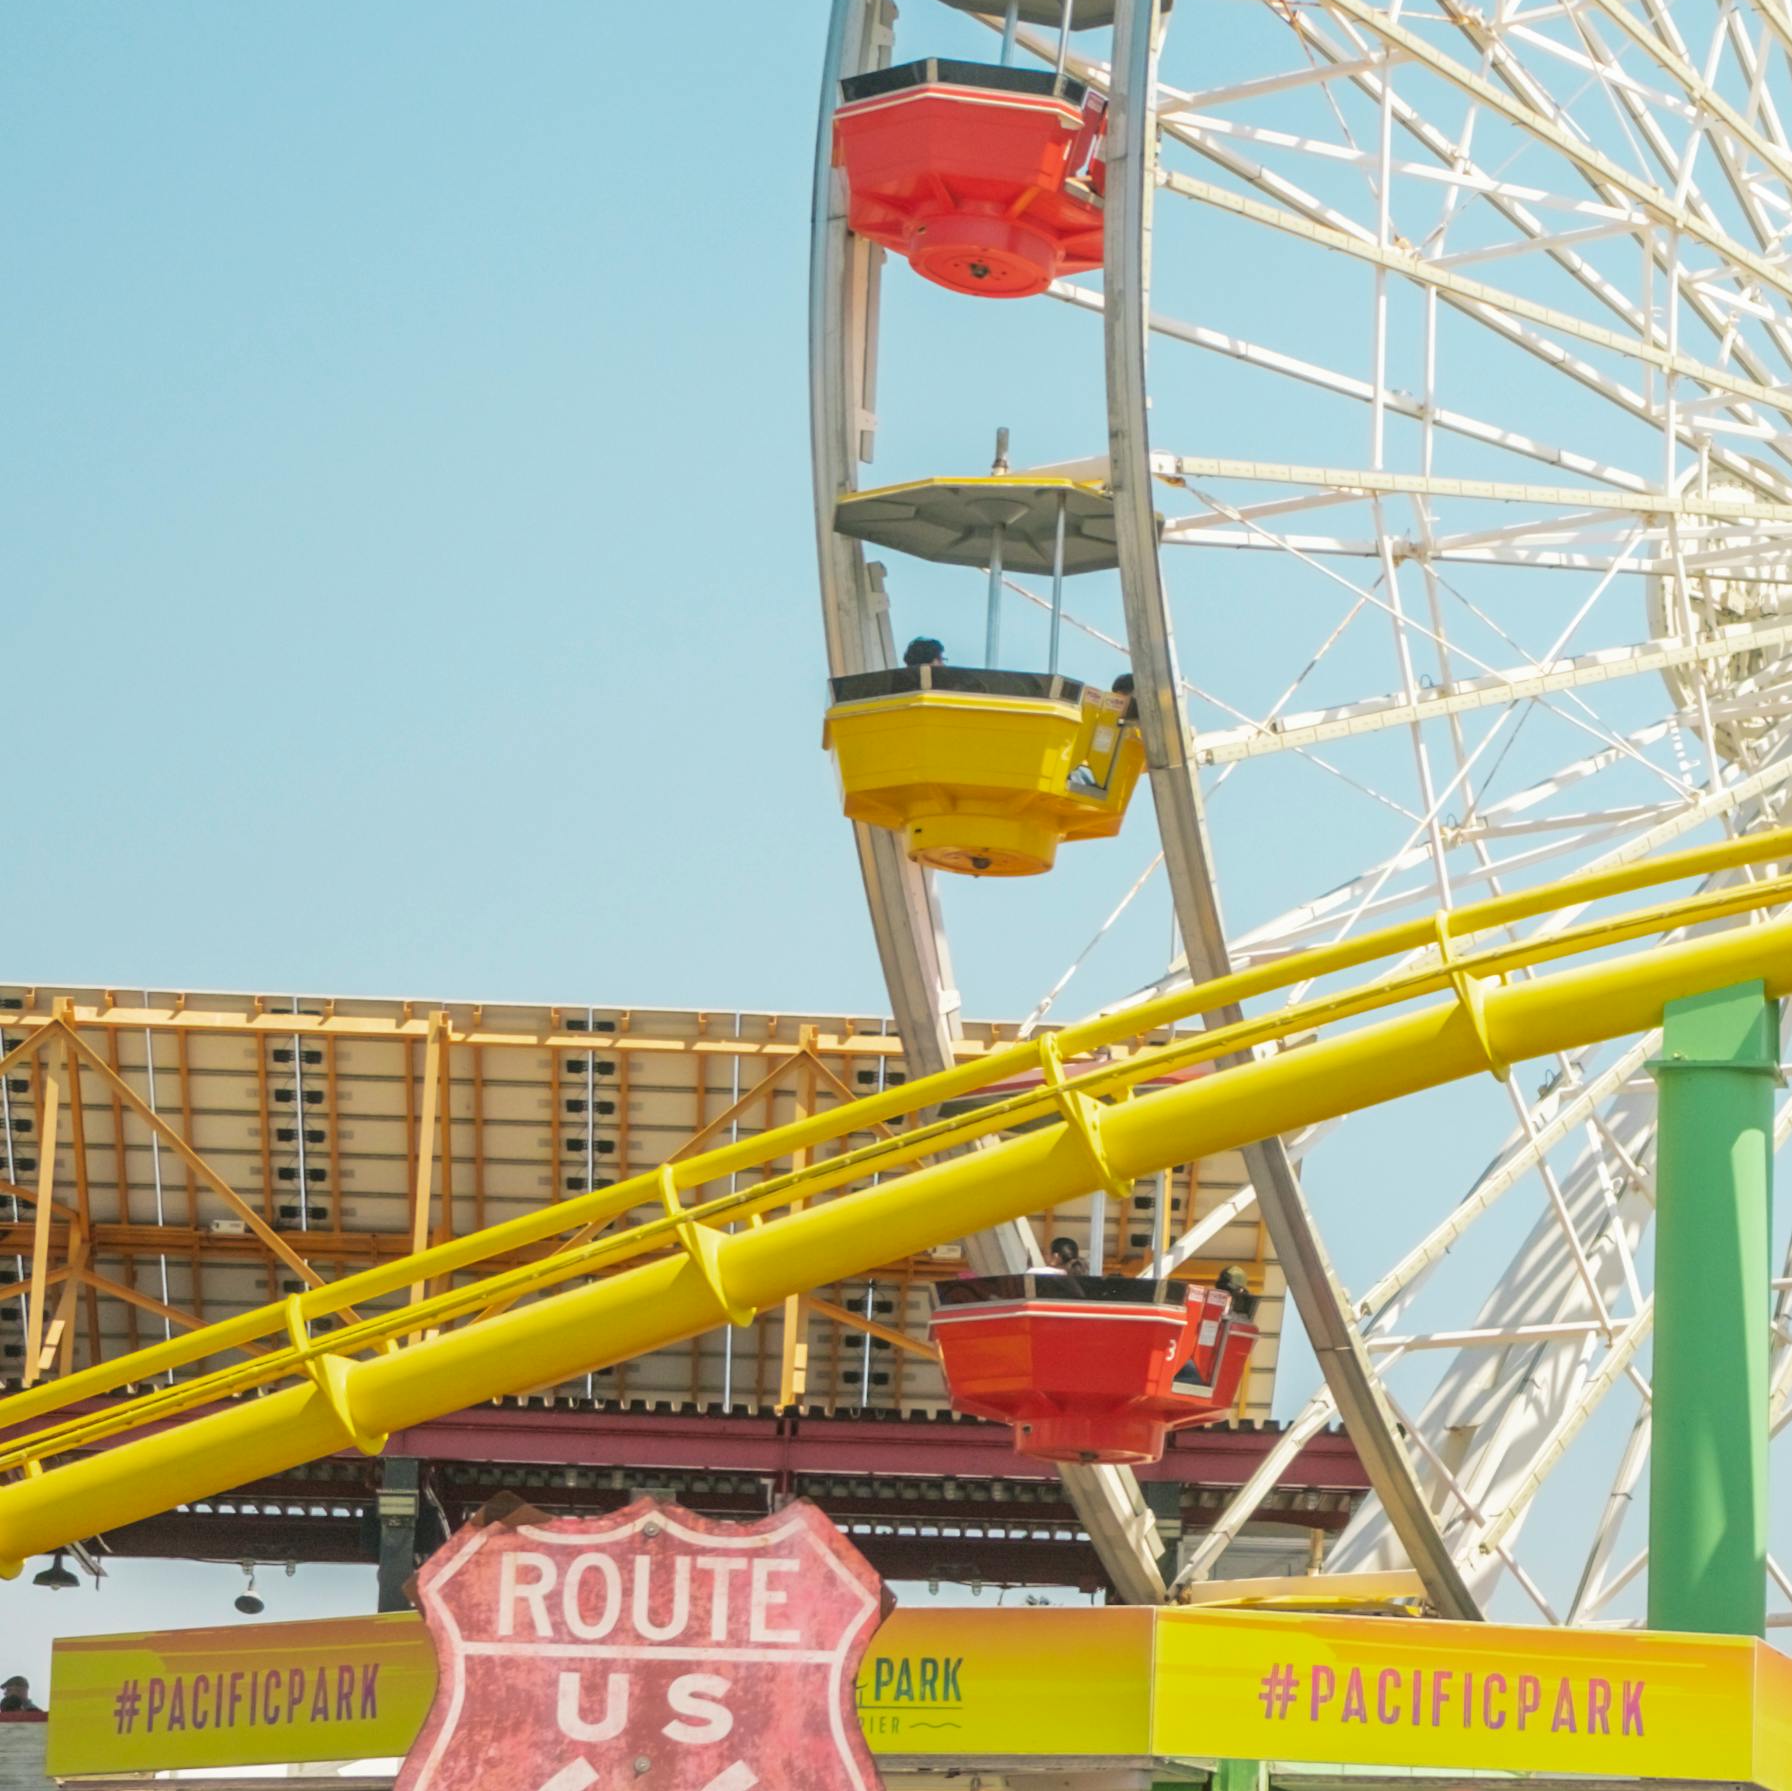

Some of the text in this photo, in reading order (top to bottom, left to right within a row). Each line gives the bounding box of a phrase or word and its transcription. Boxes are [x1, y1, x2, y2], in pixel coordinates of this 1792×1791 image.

[499, 1551, 801, 1644] ROUTE
[113, 1663, 380, 1735] #PACIFICPARK
[874, 1657, 963, 1702] PARK
[1258, 1662, 1646, 1737] #PACIFICPARK
